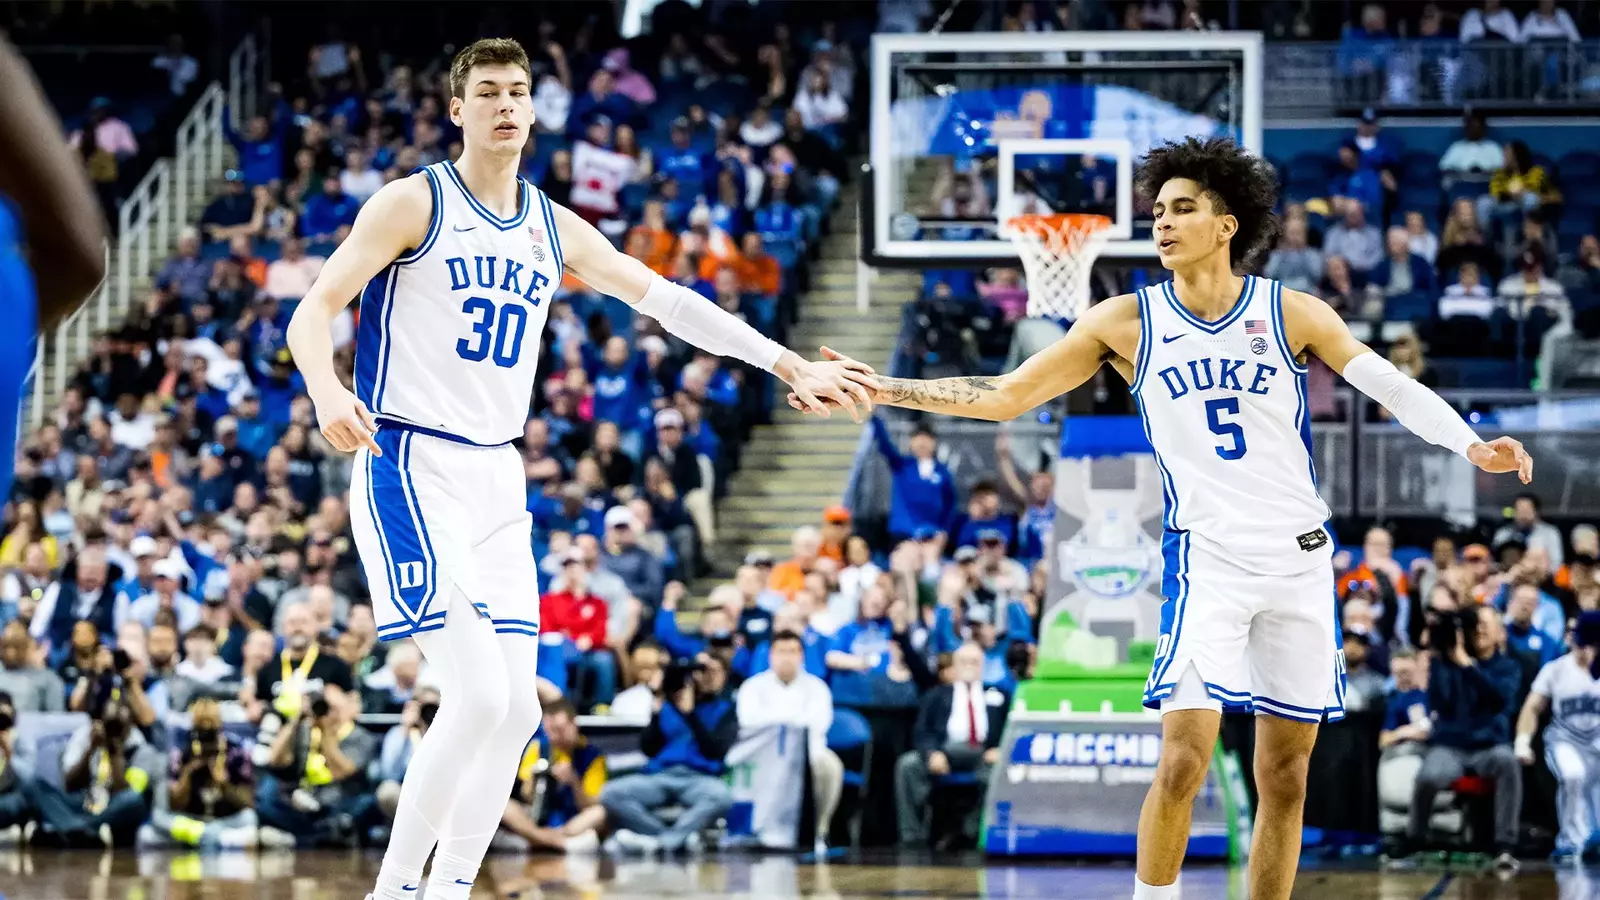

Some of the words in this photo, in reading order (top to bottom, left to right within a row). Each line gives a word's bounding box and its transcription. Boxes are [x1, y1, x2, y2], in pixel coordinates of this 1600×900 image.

[446, 256, 549, 306] DUKE
[456, 297, 527, 368] 30
[1158, 358, 1277, 400] DUKE
[1205, 397, 1247, 460] 5
[397, 561, 424, 589] D
